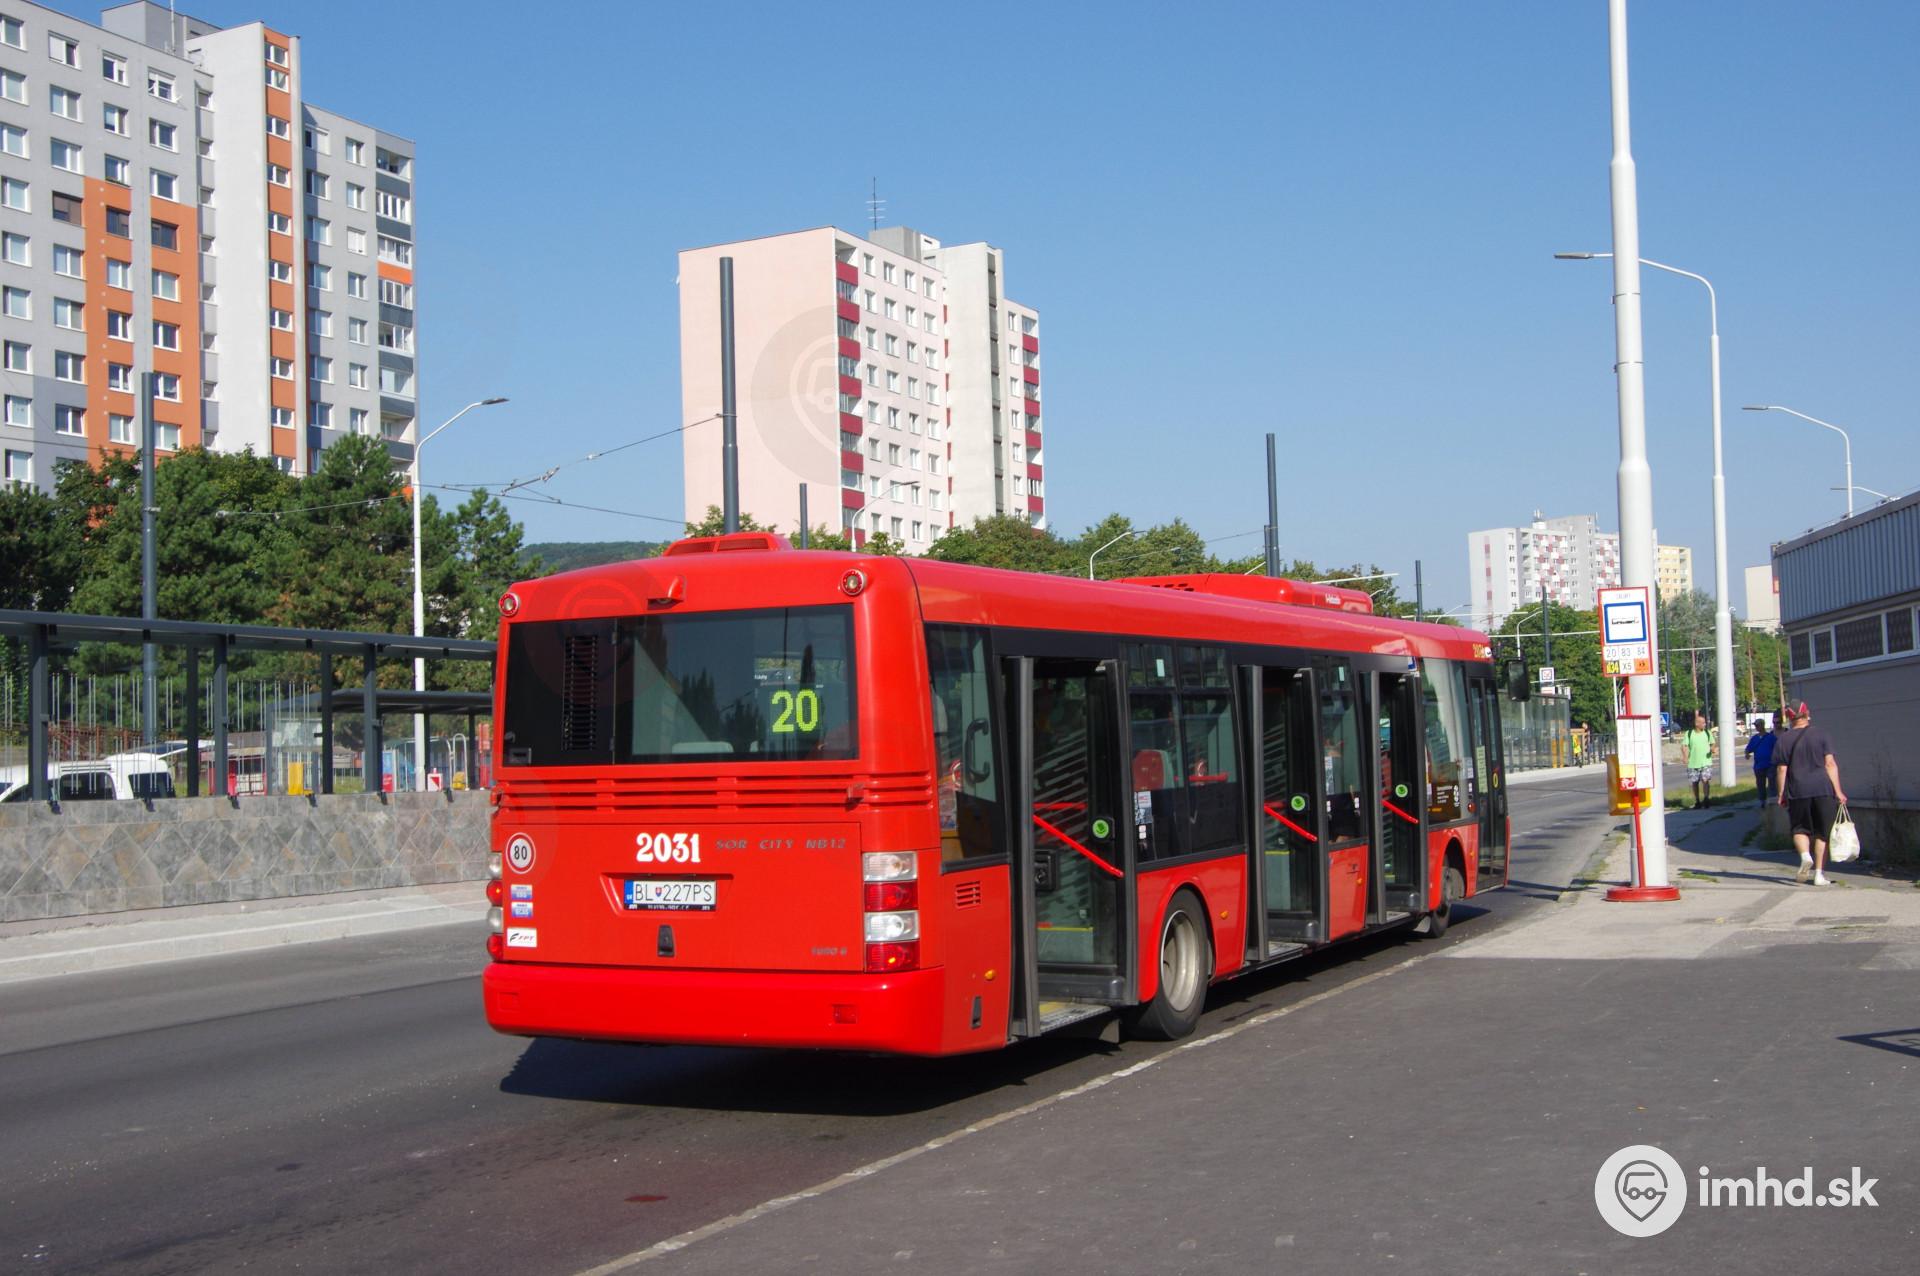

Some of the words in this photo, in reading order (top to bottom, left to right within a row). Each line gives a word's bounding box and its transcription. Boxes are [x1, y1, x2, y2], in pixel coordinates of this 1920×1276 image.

[1606, 649, 1617, 658] 20
[1621, 648, 1631, 656] 83
[771, 689, 818, 732] 20
[514, 844, 528, 860] 80
[636, 832, 701, 863] 2031
[716, 839, 748, 849] SOR
[759, 838, 794, 849] CITY
[635, 884, 654, 902] BL
[662, 884, 712, 902] 227PS
